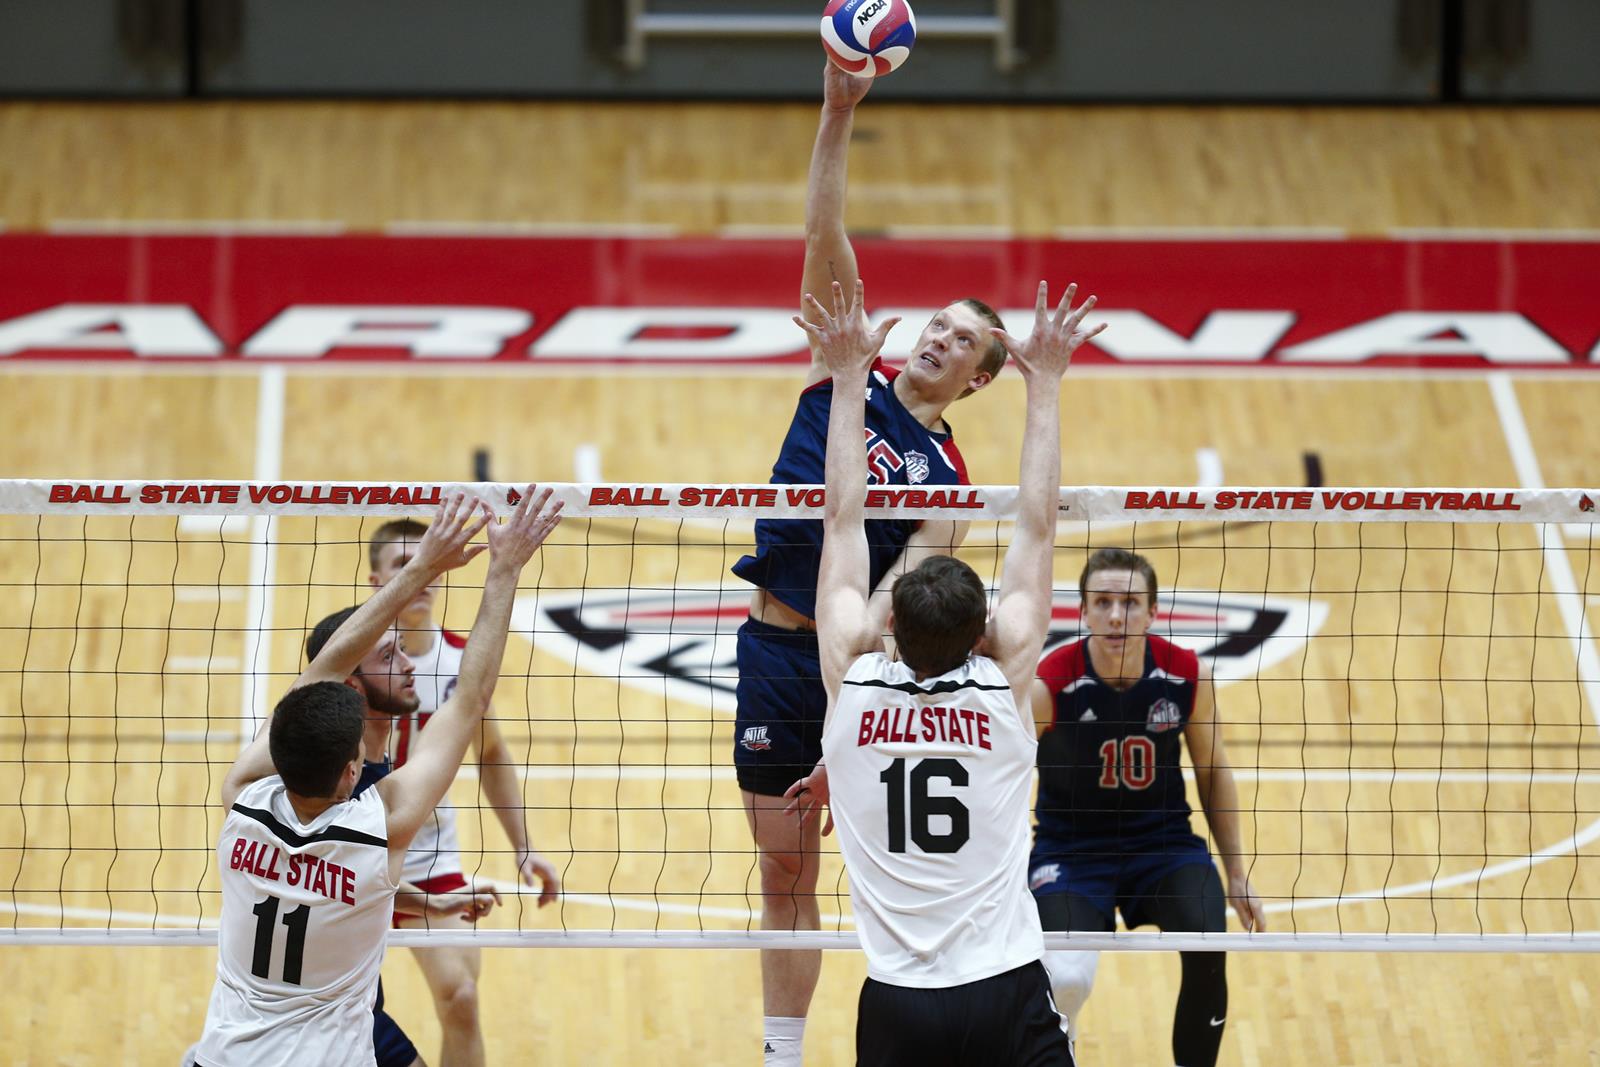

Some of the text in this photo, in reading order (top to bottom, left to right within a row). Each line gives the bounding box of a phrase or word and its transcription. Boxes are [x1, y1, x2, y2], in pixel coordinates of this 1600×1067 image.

[857, 0, 887, 25] NCAA
[49, 484, 443, 506] BALL STATE VOLLEYBALL
[588, 487, 985, 509] BALL STATE VOEYBALL
[1124, 491, 1521, 511] BALL STATE VOLLEYBALL
[858, 706, 992, 751] BALL STATE
[1099, 735, 1156, 790] 10
[880, 757, 970, 854] 16
[230, 838, 356, 906] BALL STATE
[251, 894, 311, 986] 11
